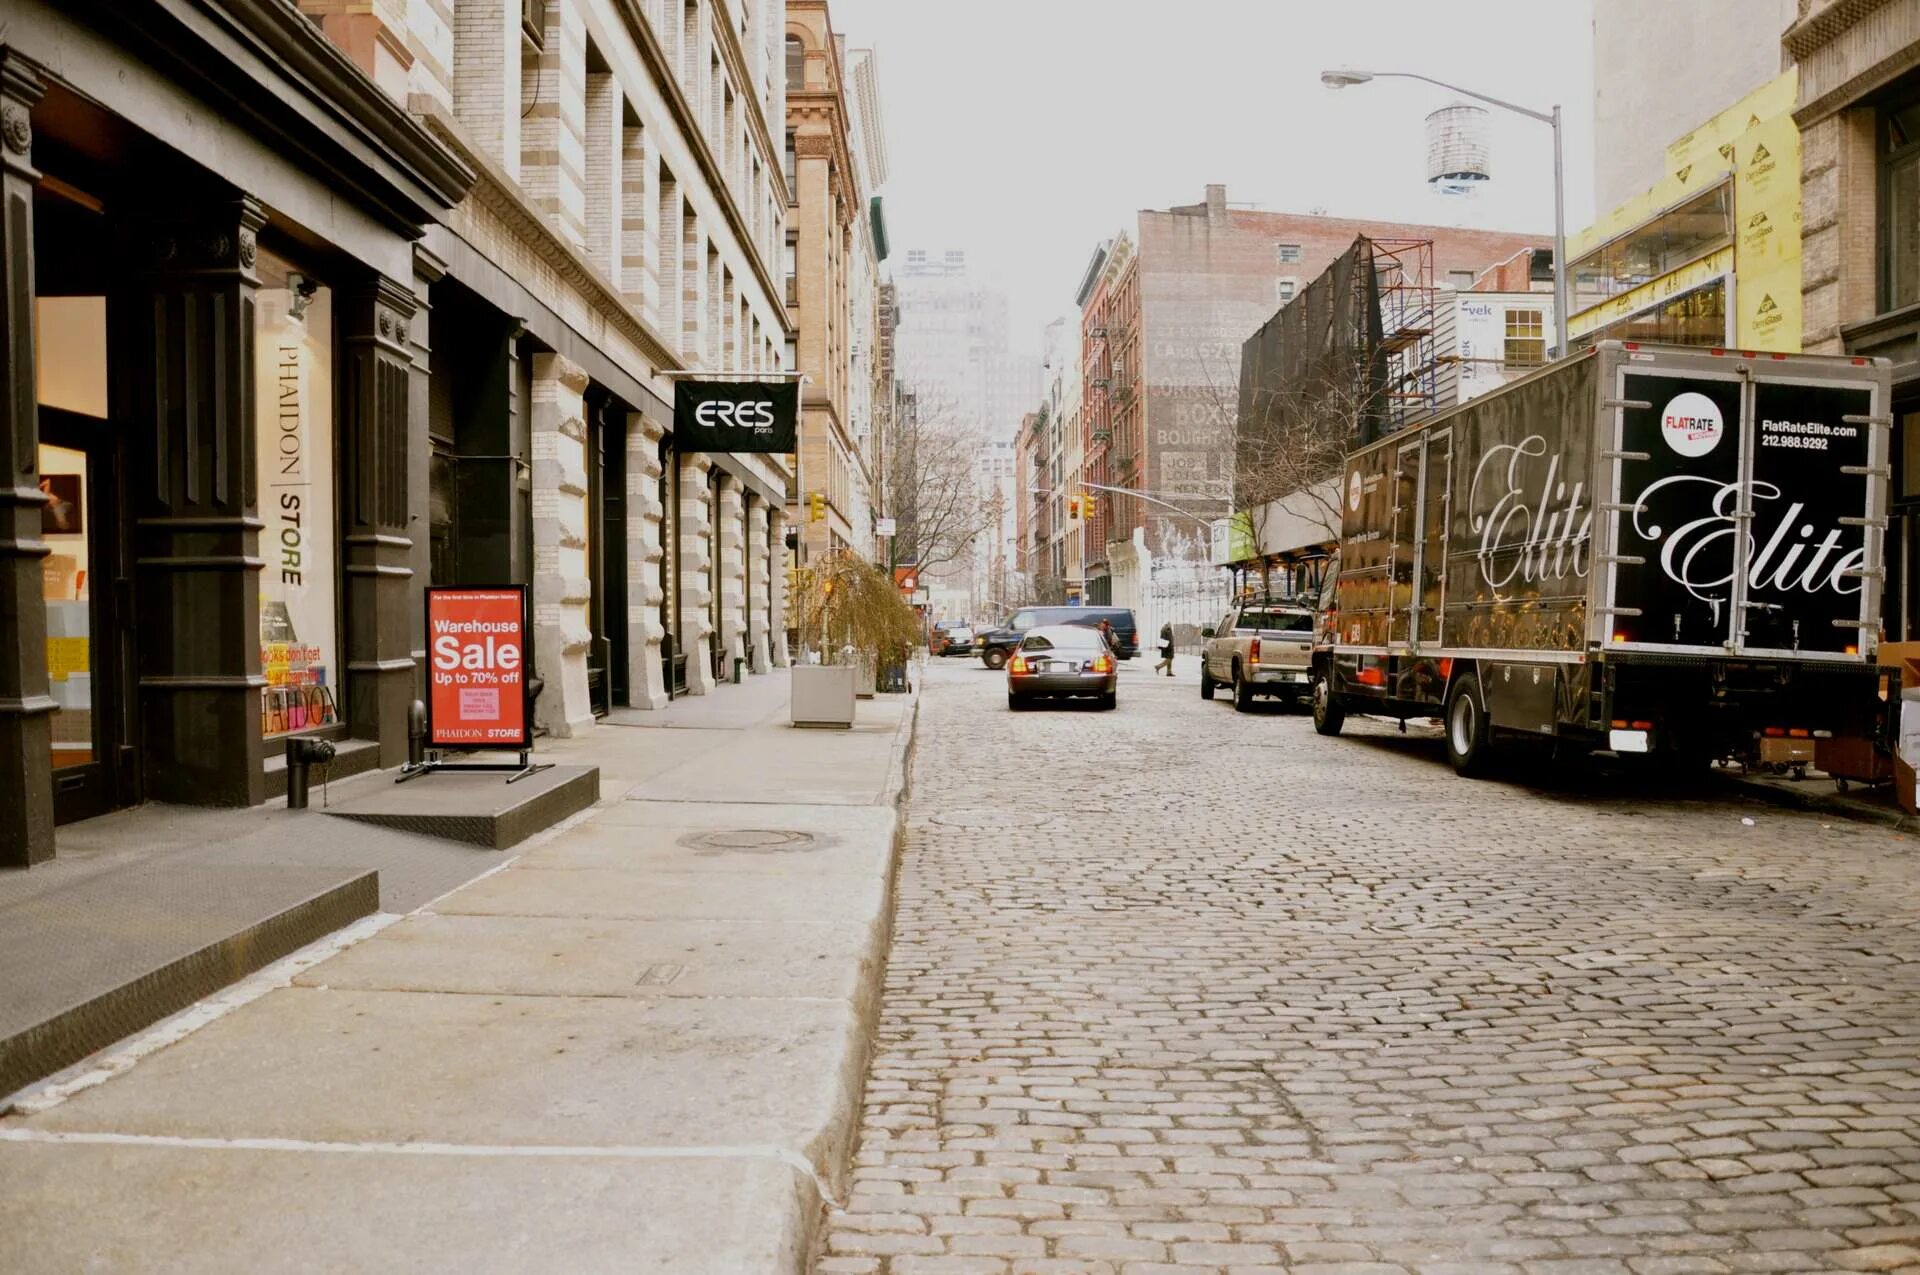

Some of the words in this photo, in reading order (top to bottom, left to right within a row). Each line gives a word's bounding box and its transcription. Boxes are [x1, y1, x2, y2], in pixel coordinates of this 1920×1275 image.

[279, 346, 300, 475] PHAIDON
[695, 400, 775, 428] ERES
[754, 427, 774, 435] paris
[1666, 415, 1714, 431] FLATRATE
[1762, 419, 1857, 438] FlatRateElite.com
[1157, 429, 1220, 446] BOUGHT
[1762, 435, 1828, 450] 212.988.9292
[1470, 435, 1592, 602] Elite
[280, 493, 302, 586] STORE
[1633, 475, 1864, 602] Elite
[434, 619, 519, 633] Warehouse
[307, 646, 320, 664] get
[434, 635, 520, 670] Sale
[435, 672, 452, 686] Up
[455, 672, 468, 683] to
[471, 672, 498, 684] 70%
[501, 672, 519, 683] off
[435, 728, 483, 738] PHAIDON
[487, 728, 521, 738] STORE
